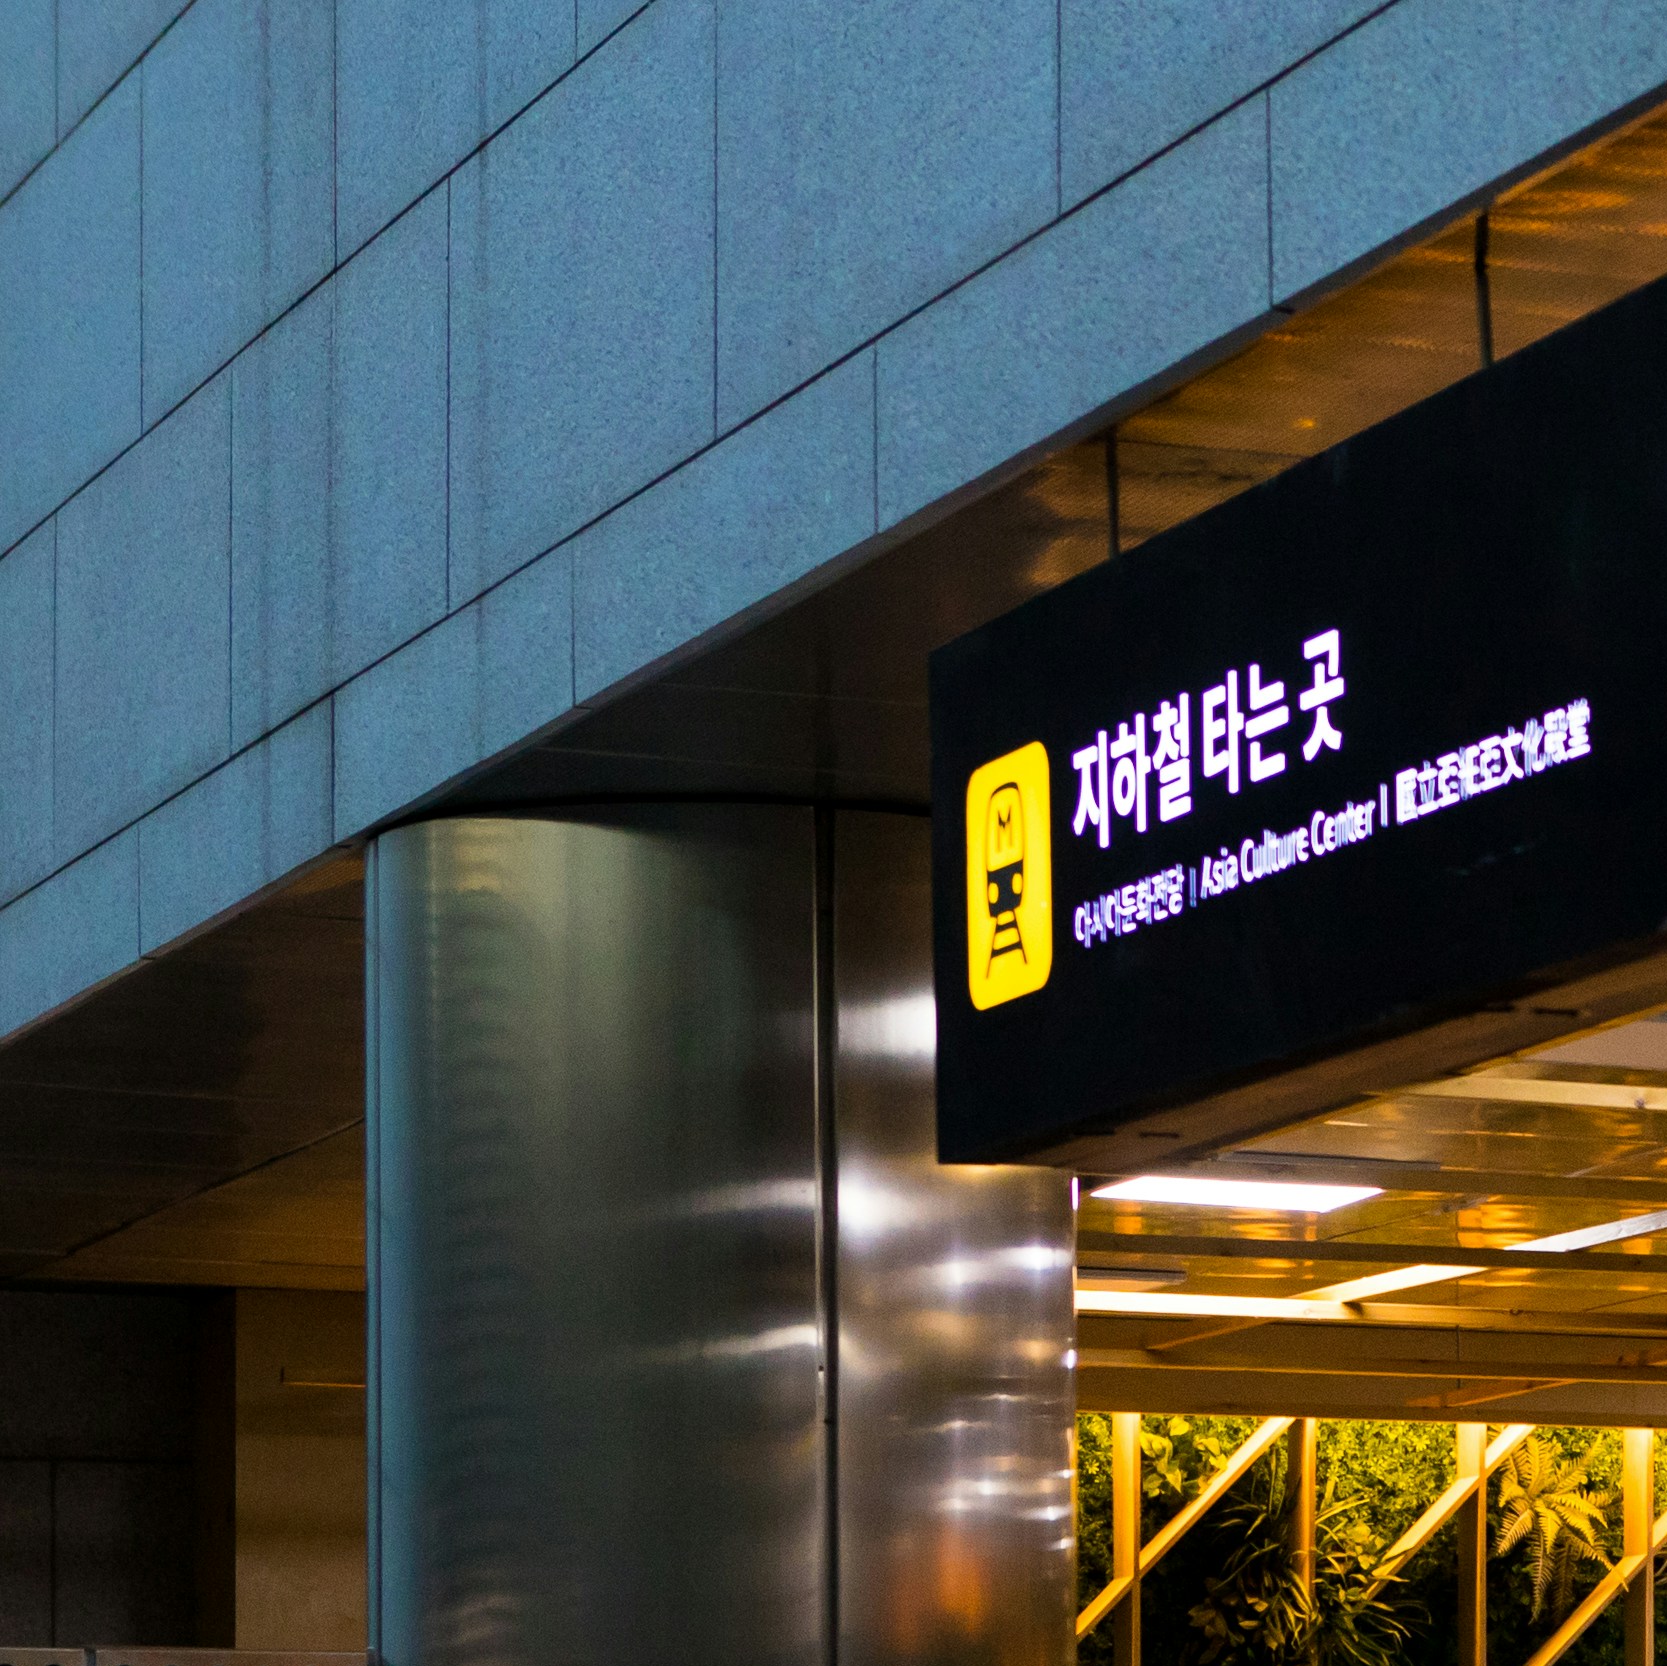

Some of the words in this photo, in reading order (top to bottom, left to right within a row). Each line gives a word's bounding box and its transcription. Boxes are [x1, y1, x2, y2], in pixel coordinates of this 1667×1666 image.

[1071, 692, 1193, 849] 지하철
[1201, 663, 1291, 795] 타는
[1298, 628, 1346, 762] 곳
[1200, 847, 1239, 899] Asia
[1240, 827, 1310, 884] Culture
[1310, 800, 1376, 857] Center
